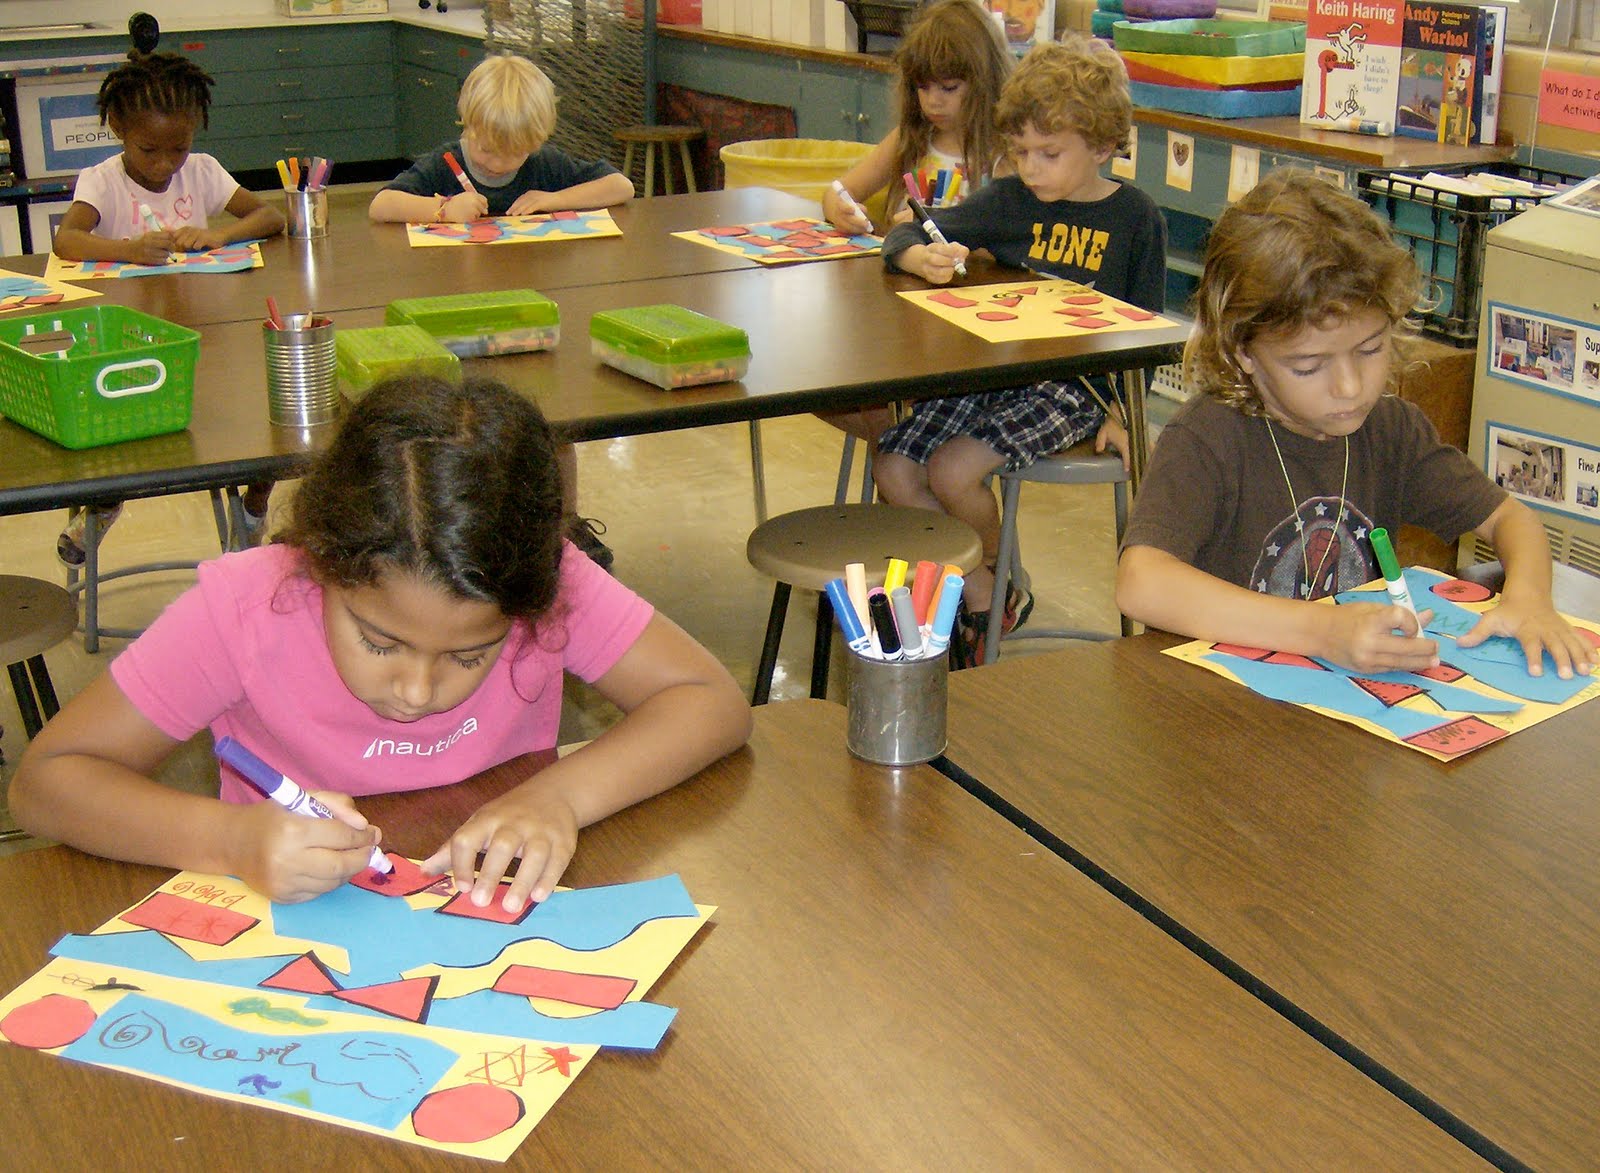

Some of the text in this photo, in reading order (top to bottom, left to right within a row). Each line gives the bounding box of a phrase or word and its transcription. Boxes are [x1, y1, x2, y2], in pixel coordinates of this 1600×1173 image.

[1316, 0, 1396, 24] Keith Haring
[1404, 4, 1439, 25] Andy
[1419, 26, 1469, 48] Warhol
[1545, 82, 1569, 96] What
[1571, 88, 1583, 98] do
[1586, 88, 1591, 100] I
[65, 131, 119, 144] PEOPL
[1028, 223, 1110, 272] LONE
[1578, 457, 1595, 473] Fine
[377, 717, 478, 757] nautica
